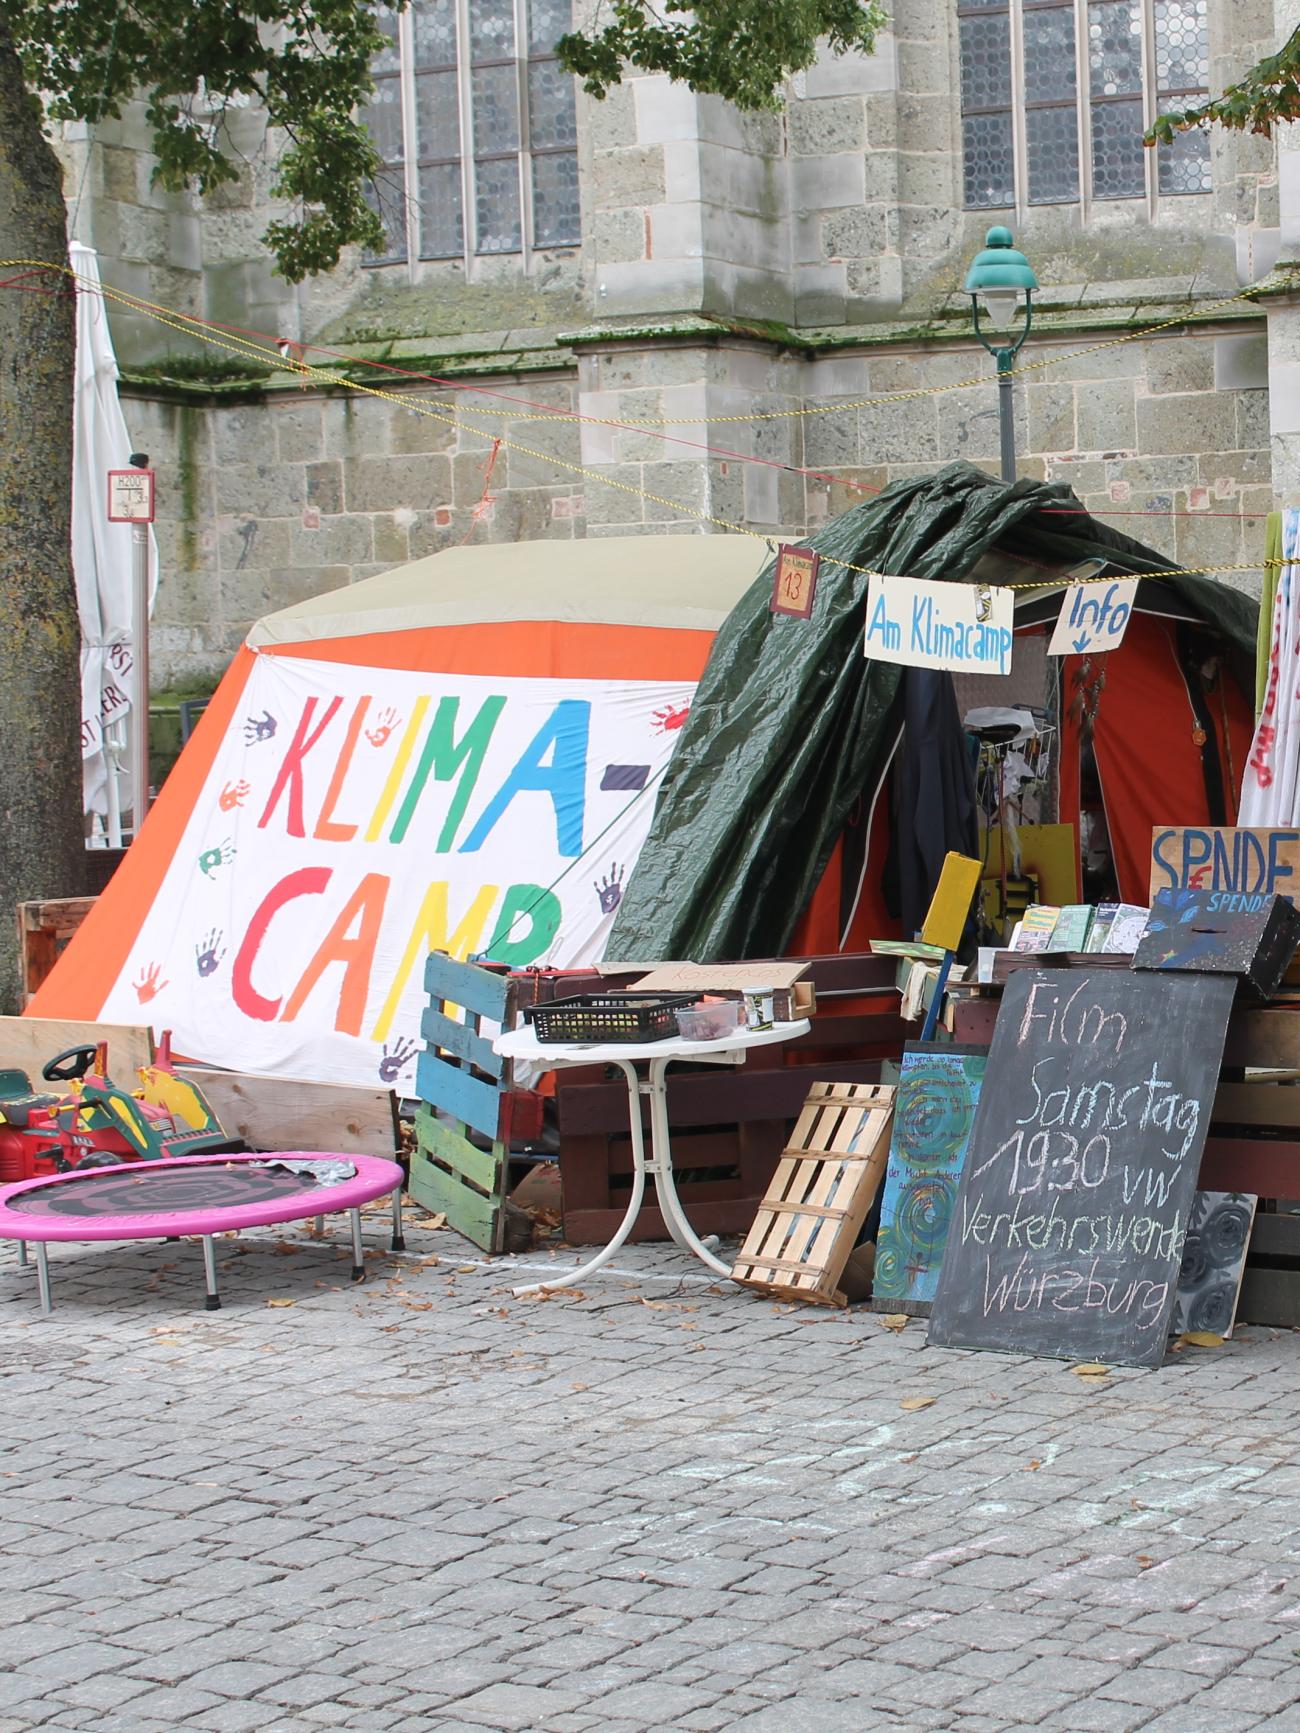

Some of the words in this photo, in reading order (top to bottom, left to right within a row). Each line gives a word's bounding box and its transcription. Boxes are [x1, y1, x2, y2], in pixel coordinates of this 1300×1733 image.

[785, 572, 802, 600] 13
[1068, 583, 1131, 636] Info
[867, 594, 901, 651] Am
[911, 594, 1012, 674] Klimacamp
[259, 695, 650, 857] KLIMA-
[232, 867, 562, 1042] CAMP
[1018, 979, 1127, 1053] Film
[1015, 1057, 1201, 1160] Samstag
[961, 1193, 1187, 1265] Verkehrswende
[984, 1253, 1169, 1330] Würzburg
